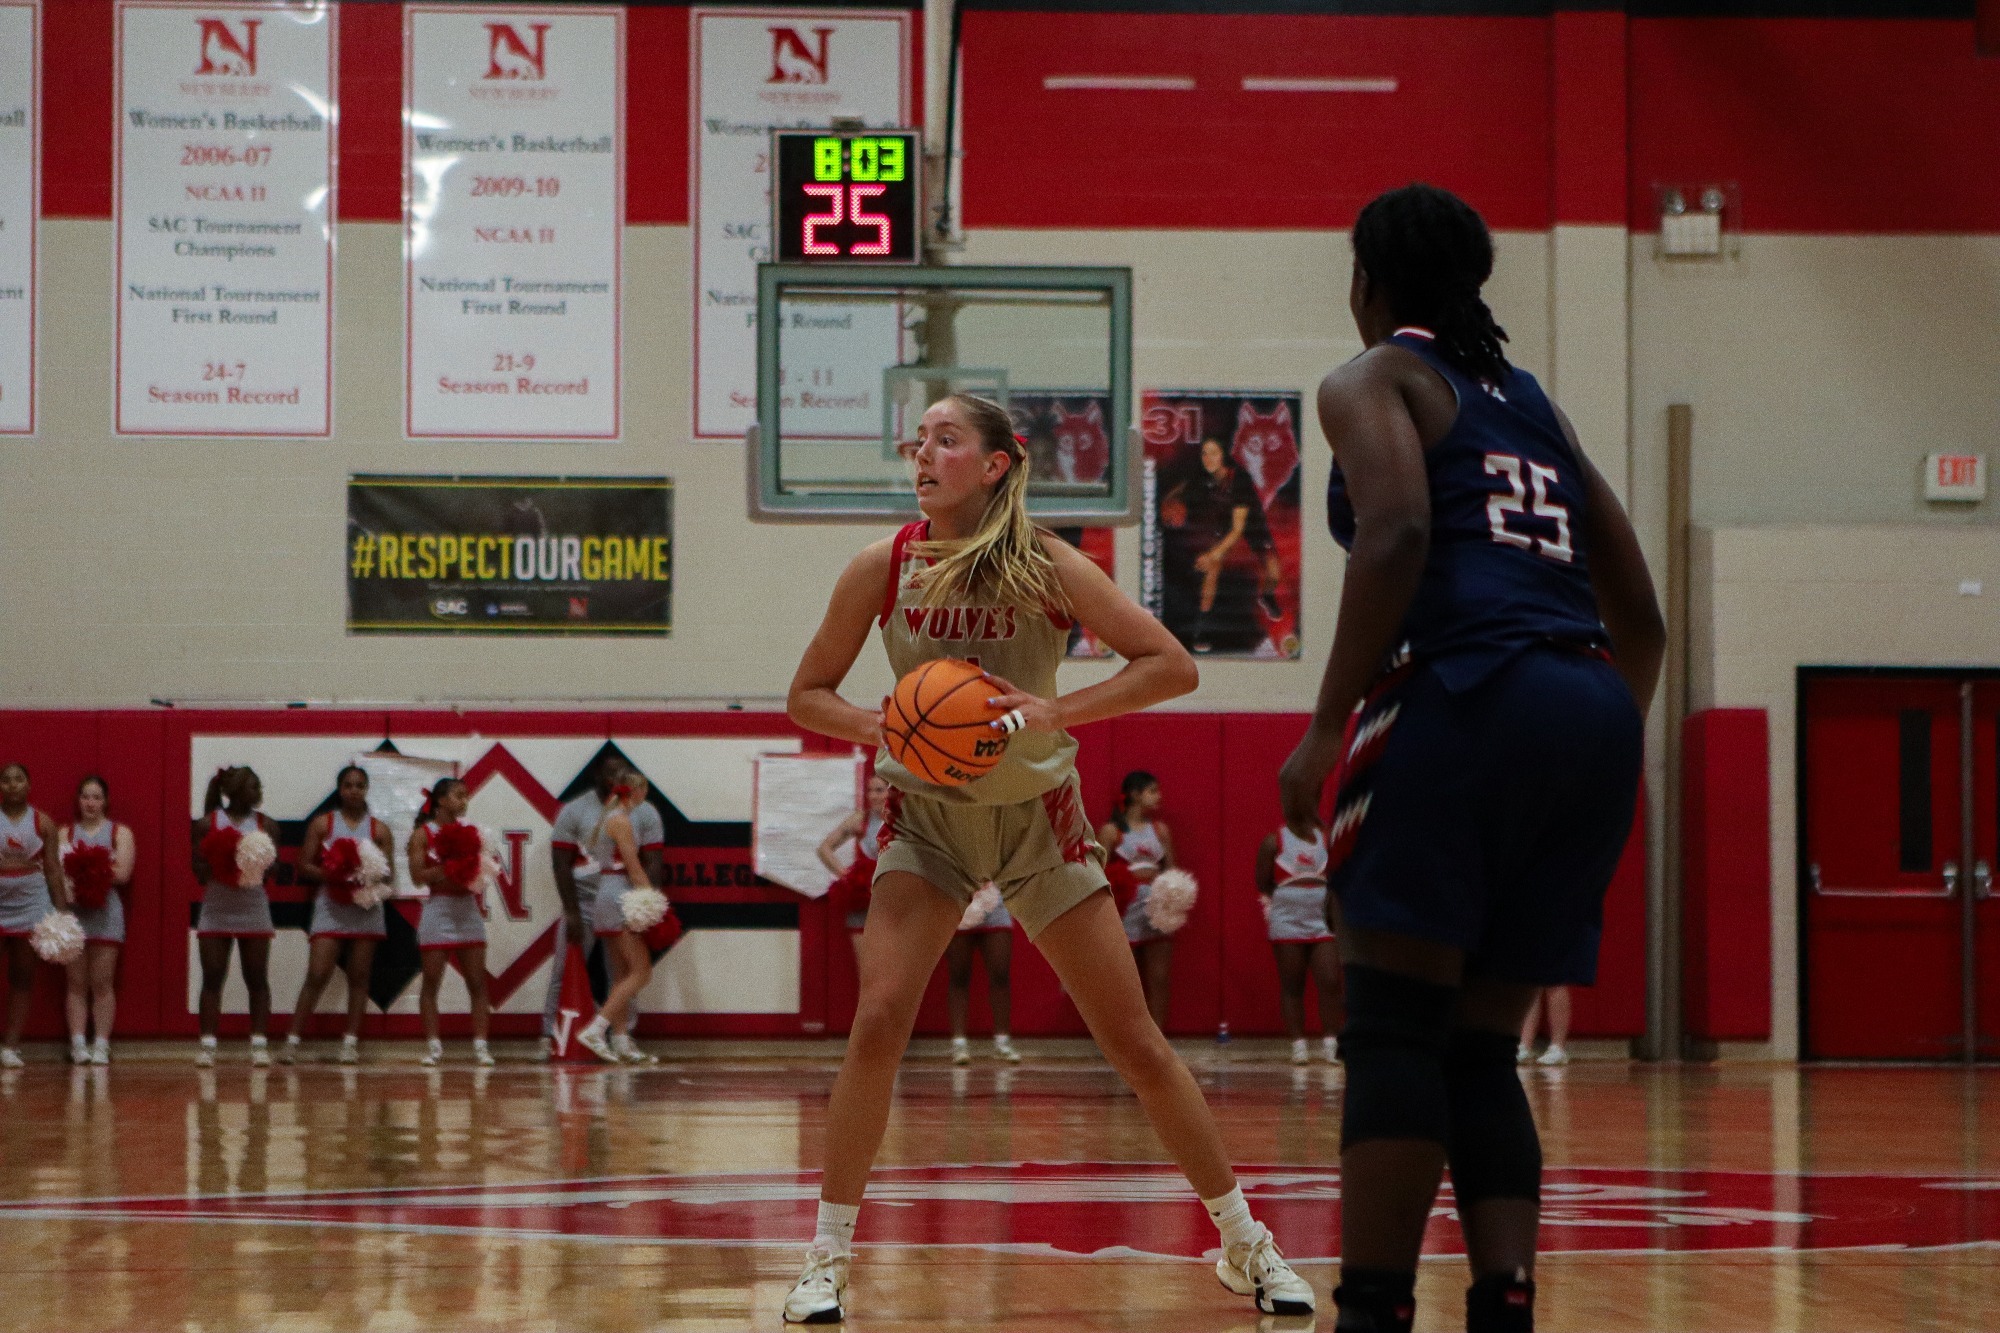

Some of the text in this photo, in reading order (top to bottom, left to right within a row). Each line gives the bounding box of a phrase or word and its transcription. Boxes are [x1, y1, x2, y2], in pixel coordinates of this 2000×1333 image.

[129, 110, 322, 131] Women's Basketball
[416, 133, 612, 152] Women's Basketball
[180, 144, 272, 167] 2006-07
[814, 137, 905, 181] 8:03
[185, 186, 244, 201] NCAA
[470, 176, 560, 197] 2009-10
[149, 217, 301, 234] SAC Tournament
[802, 183, 891, 255] 25
[475, 227, 533, 243] NCAA
[174, 240, 276, 260] Champions
[128, 284, 320, 302] National Tournament
[420, 276, 609, 293] National Tournament
[171, 307, 278, 324] First Round
[461, 299, 567, 315] First Round
[202, 362, 247, 381] 24-7
[493, 353, 536, 372] 21-9
[148, 385, 299, 404] Season Record
[439, 376, 589, 394] Season Record
[1143, 407, 1203, 444] 31
[1937, 456, 1978, 486] EXIT
[1484, 452, 1572, 562] 25
[352, 533, 669, 580] #RESPECTOURGAME
[435, 600, 468, 615] SAC
[902, 605, 1017, 644] WOLVES
